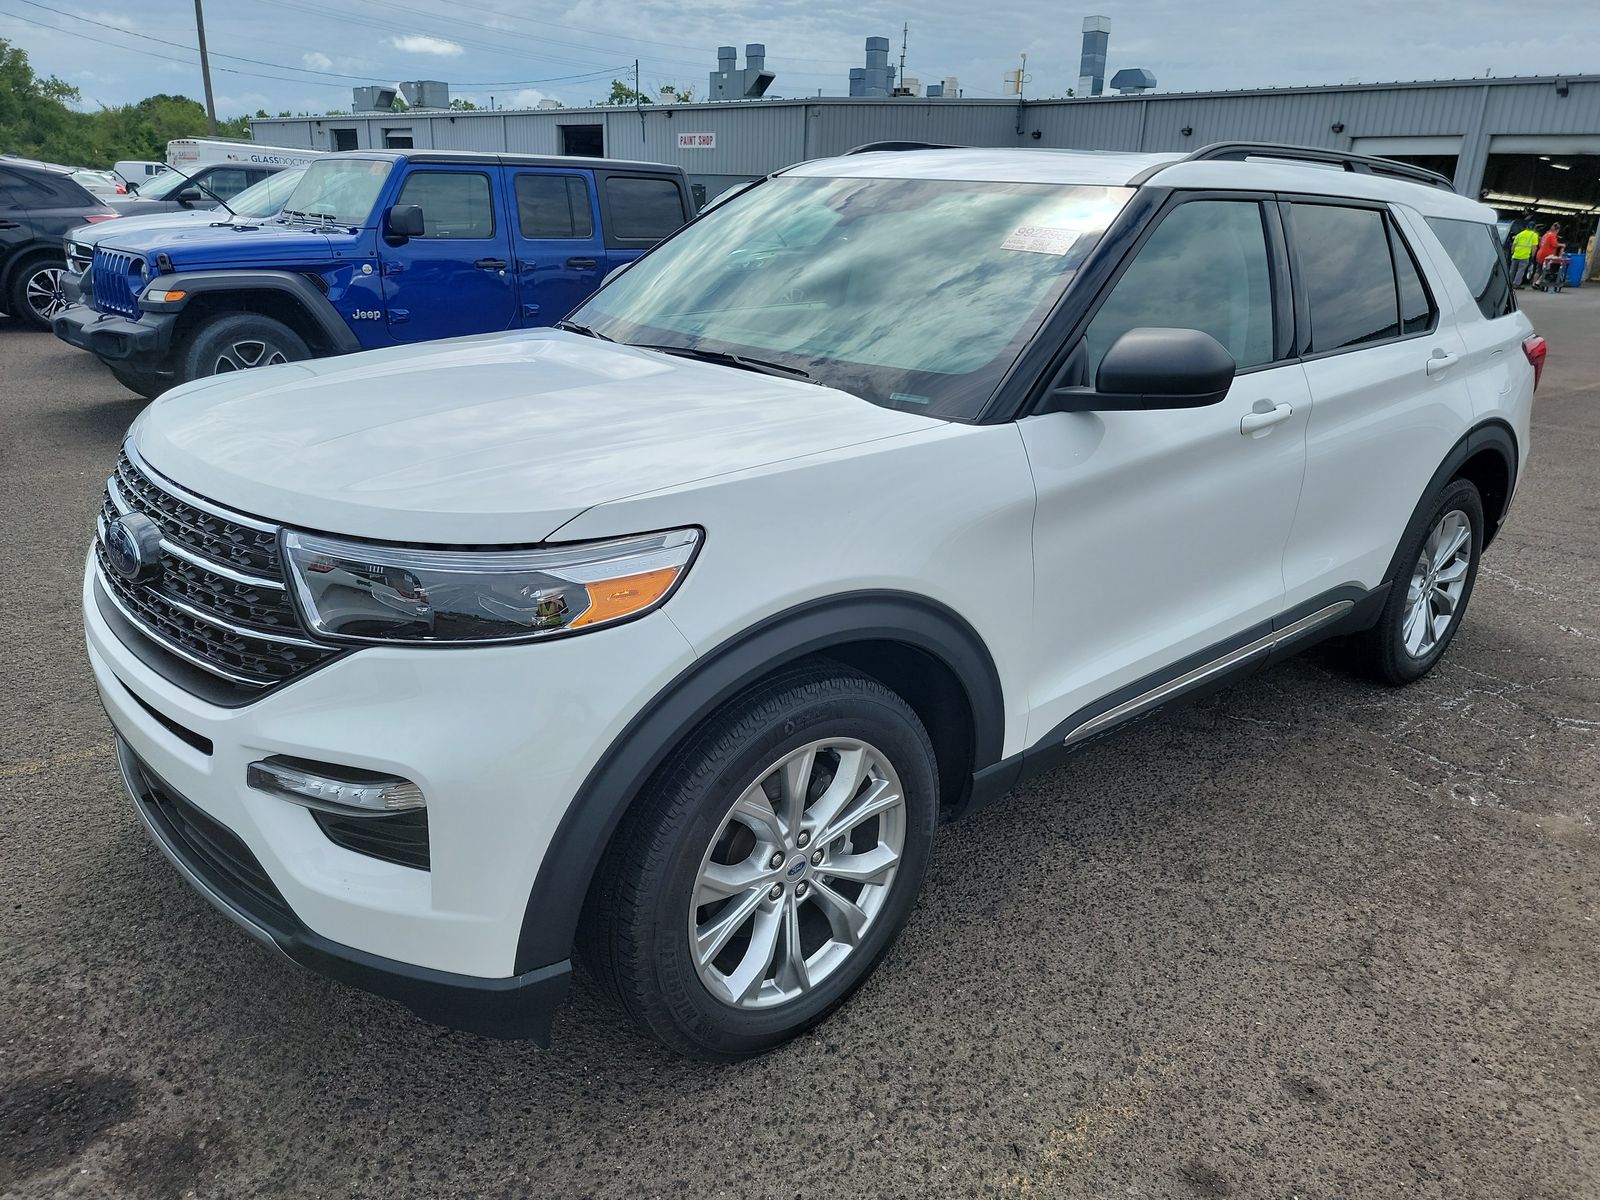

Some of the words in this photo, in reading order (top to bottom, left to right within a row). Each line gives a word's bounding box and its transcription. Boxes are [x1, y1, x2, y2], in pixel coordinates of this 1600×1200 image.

[680, 135, 696, 146] PAINT
[698, 135, 714, 146] SHOP
[352, 308, 381, 320] Jeep
